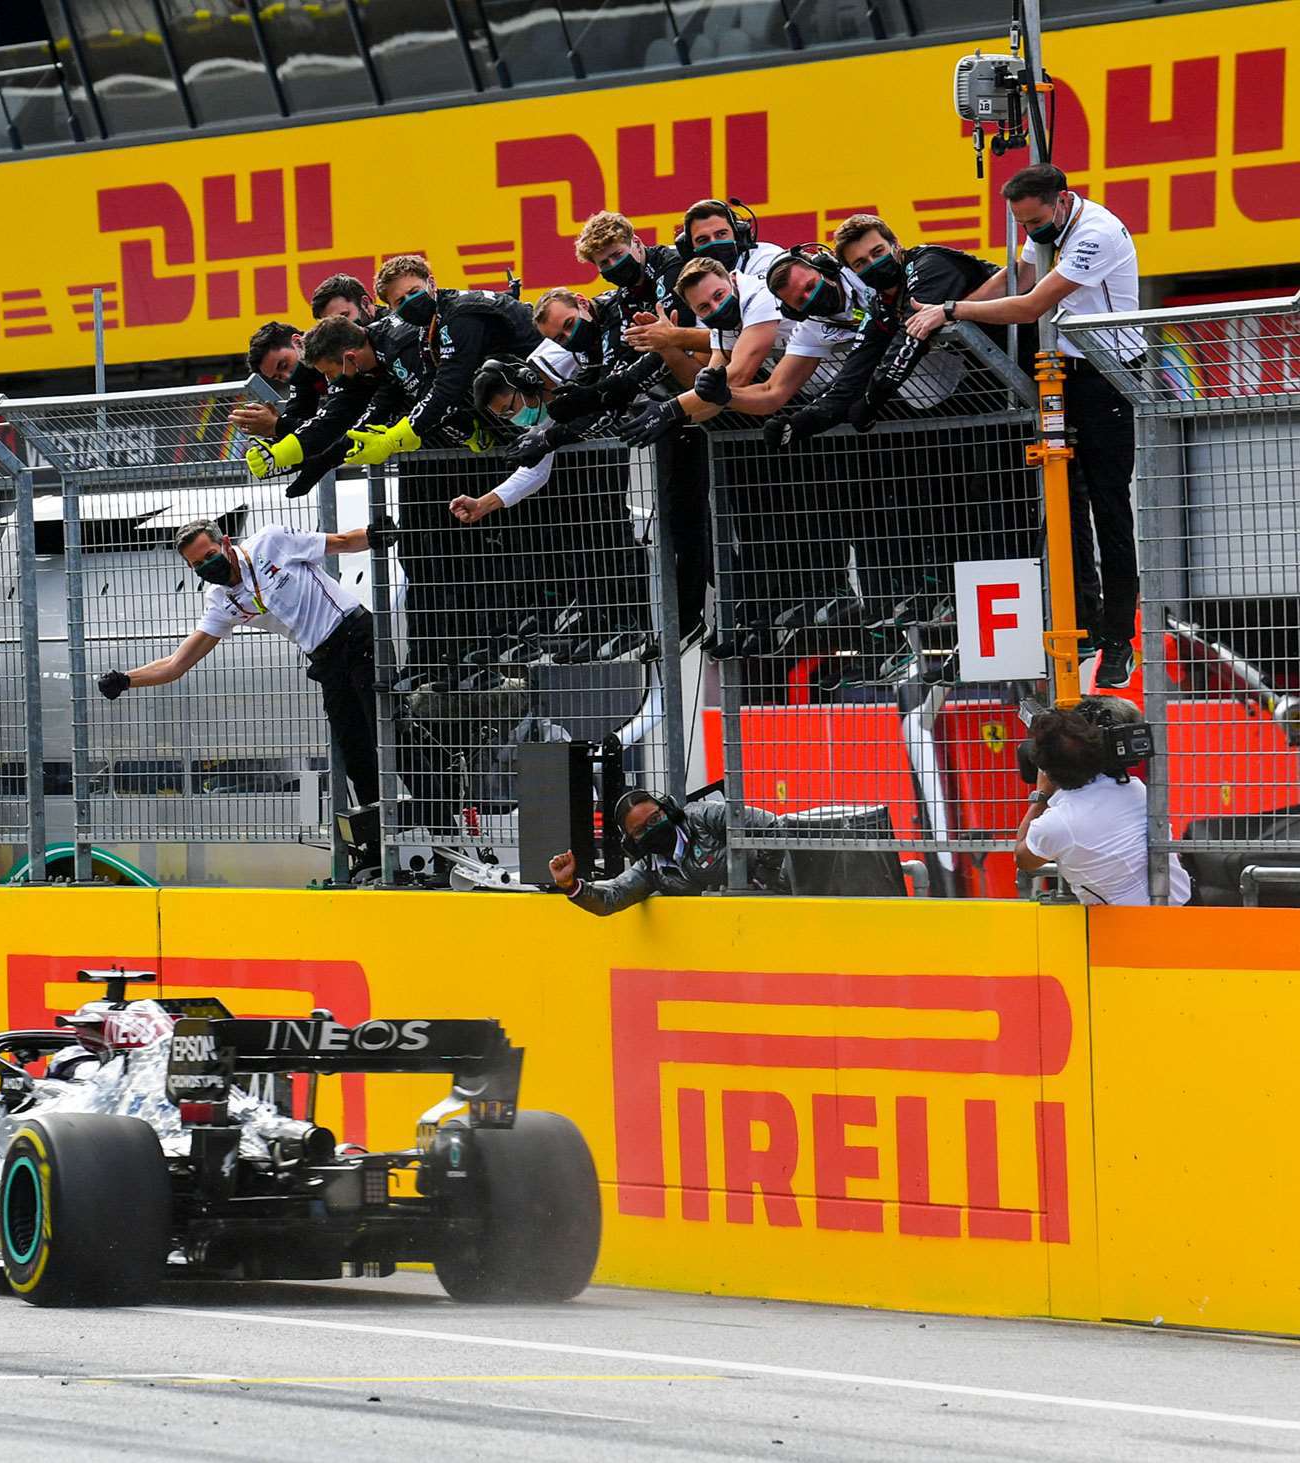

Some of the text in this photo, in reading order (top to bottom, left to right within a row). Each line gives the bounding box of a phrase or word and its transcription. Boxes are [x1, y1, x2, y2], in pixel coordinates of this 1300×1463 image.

[496, 111, 817, 289] DHL
[961, 48, 1300, 249] DHL
[96, 162, 376, 328] DHL
[975, 582, 1021, 658] F
[172, 1035, 218, 1062] EPSON
[264, 1019, 433, 1051] INEOS
[610, 968, 1073, 1245] PIRELLI
